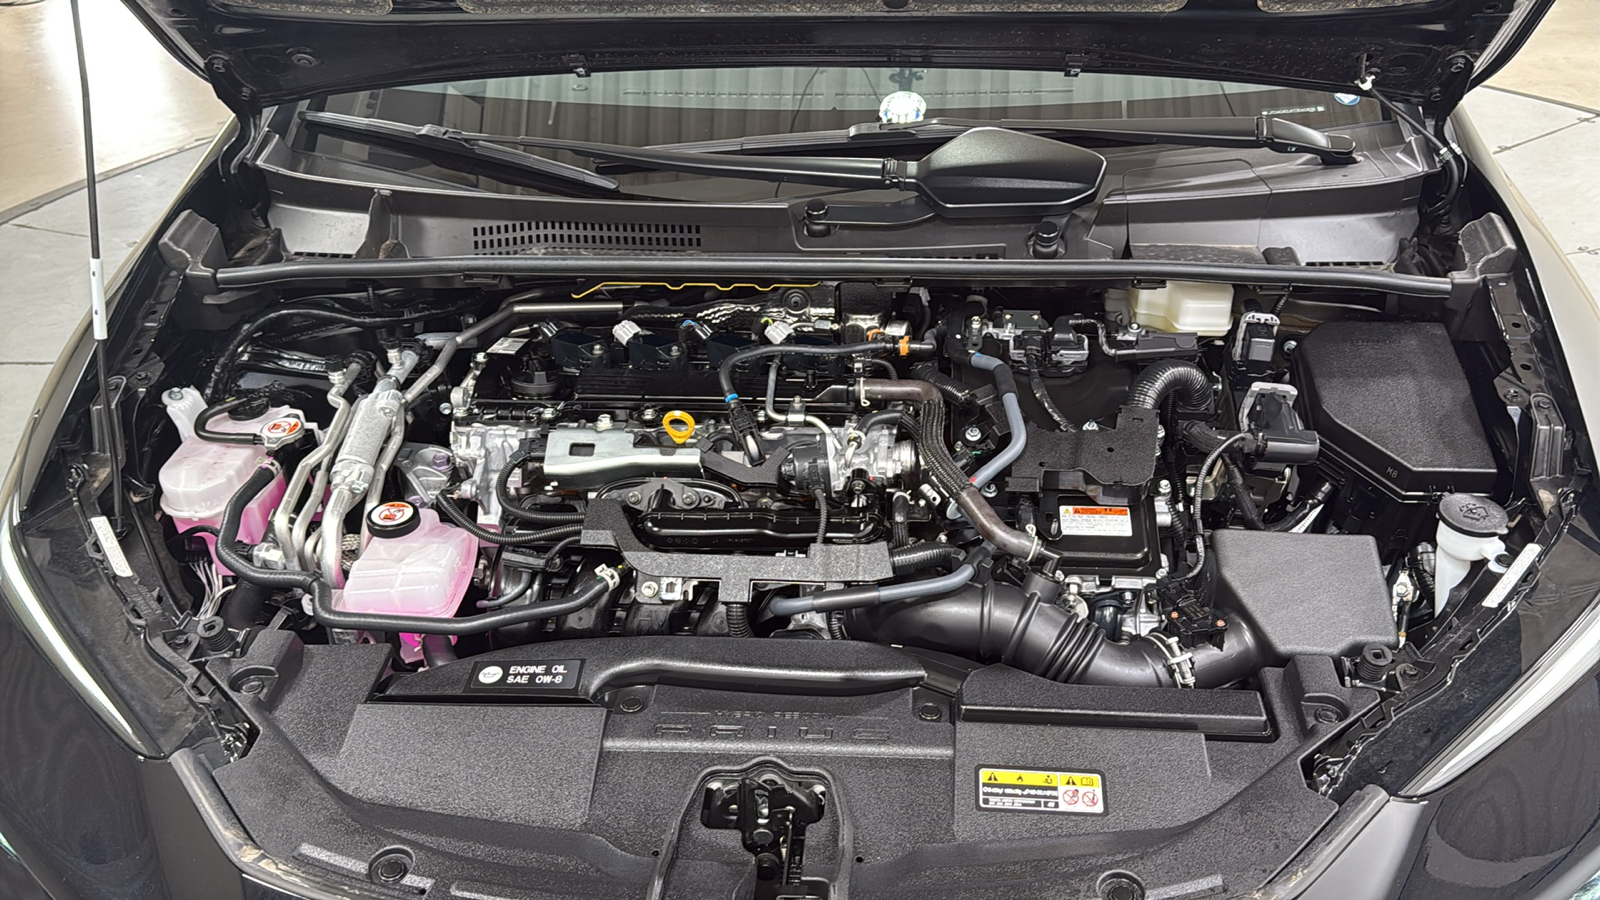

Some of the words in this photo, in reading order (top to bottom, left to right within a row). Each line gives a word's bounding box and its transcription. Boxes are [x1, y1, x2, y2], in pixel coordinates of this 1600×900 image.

[508, 665, 547, 674] ENGINE
[551, 664, 568, 674] OIL
[506, 675, 530, 684] SAE
[654, 723, 890, 740] PRIUS
